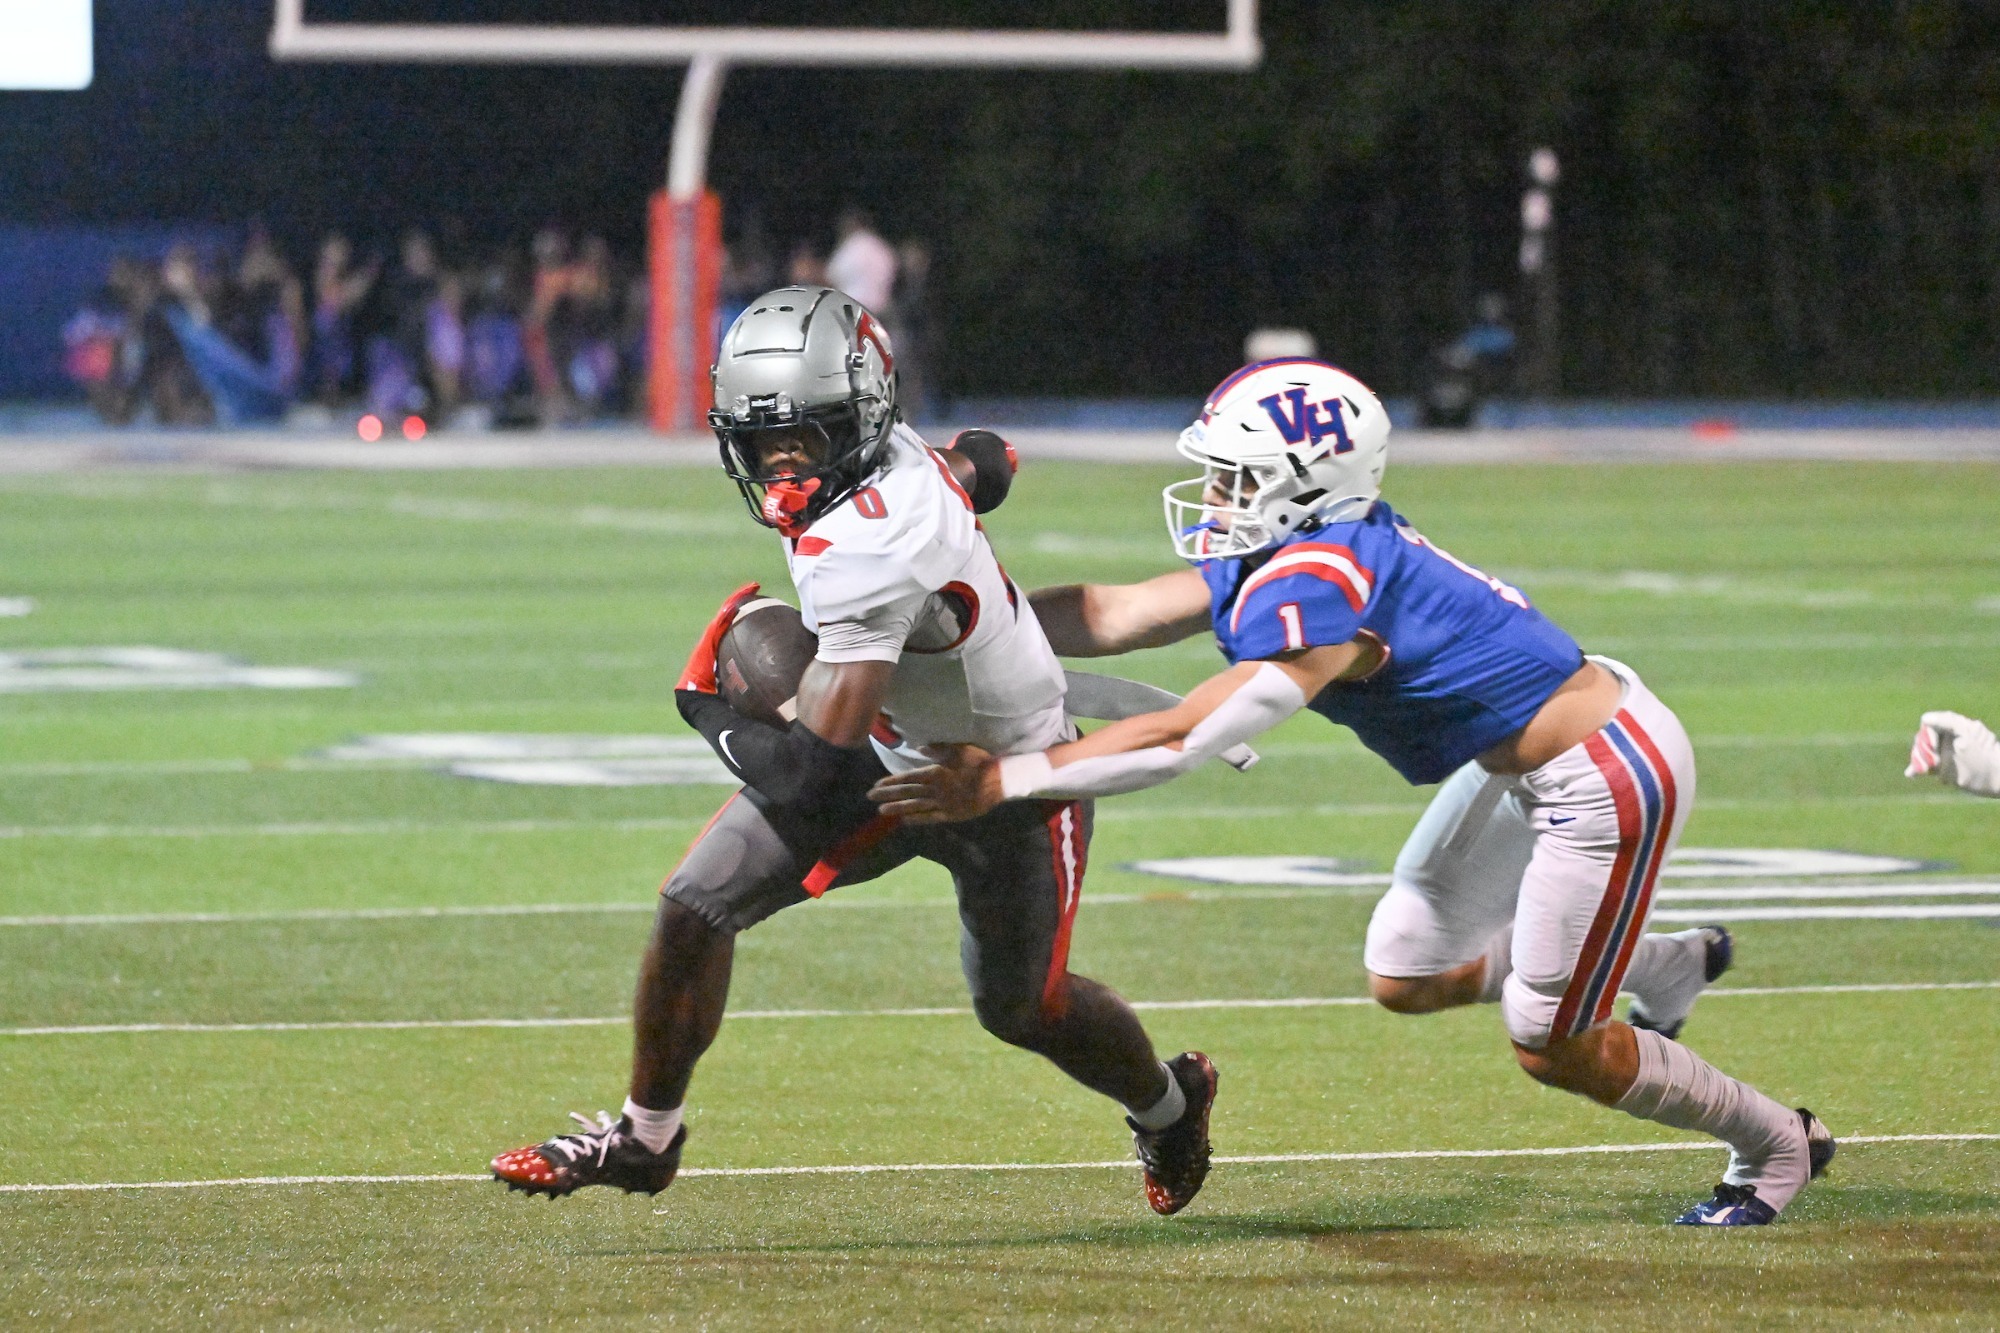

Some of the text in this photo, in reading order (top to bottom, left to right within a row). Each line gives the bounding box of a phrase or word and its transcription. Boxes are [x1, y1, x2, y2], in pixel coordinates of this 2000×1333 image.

[1257, 387, 1355, 459] VH
[852, 487, 888, 519] 0
[1278, 602, 1308, 651] 1
